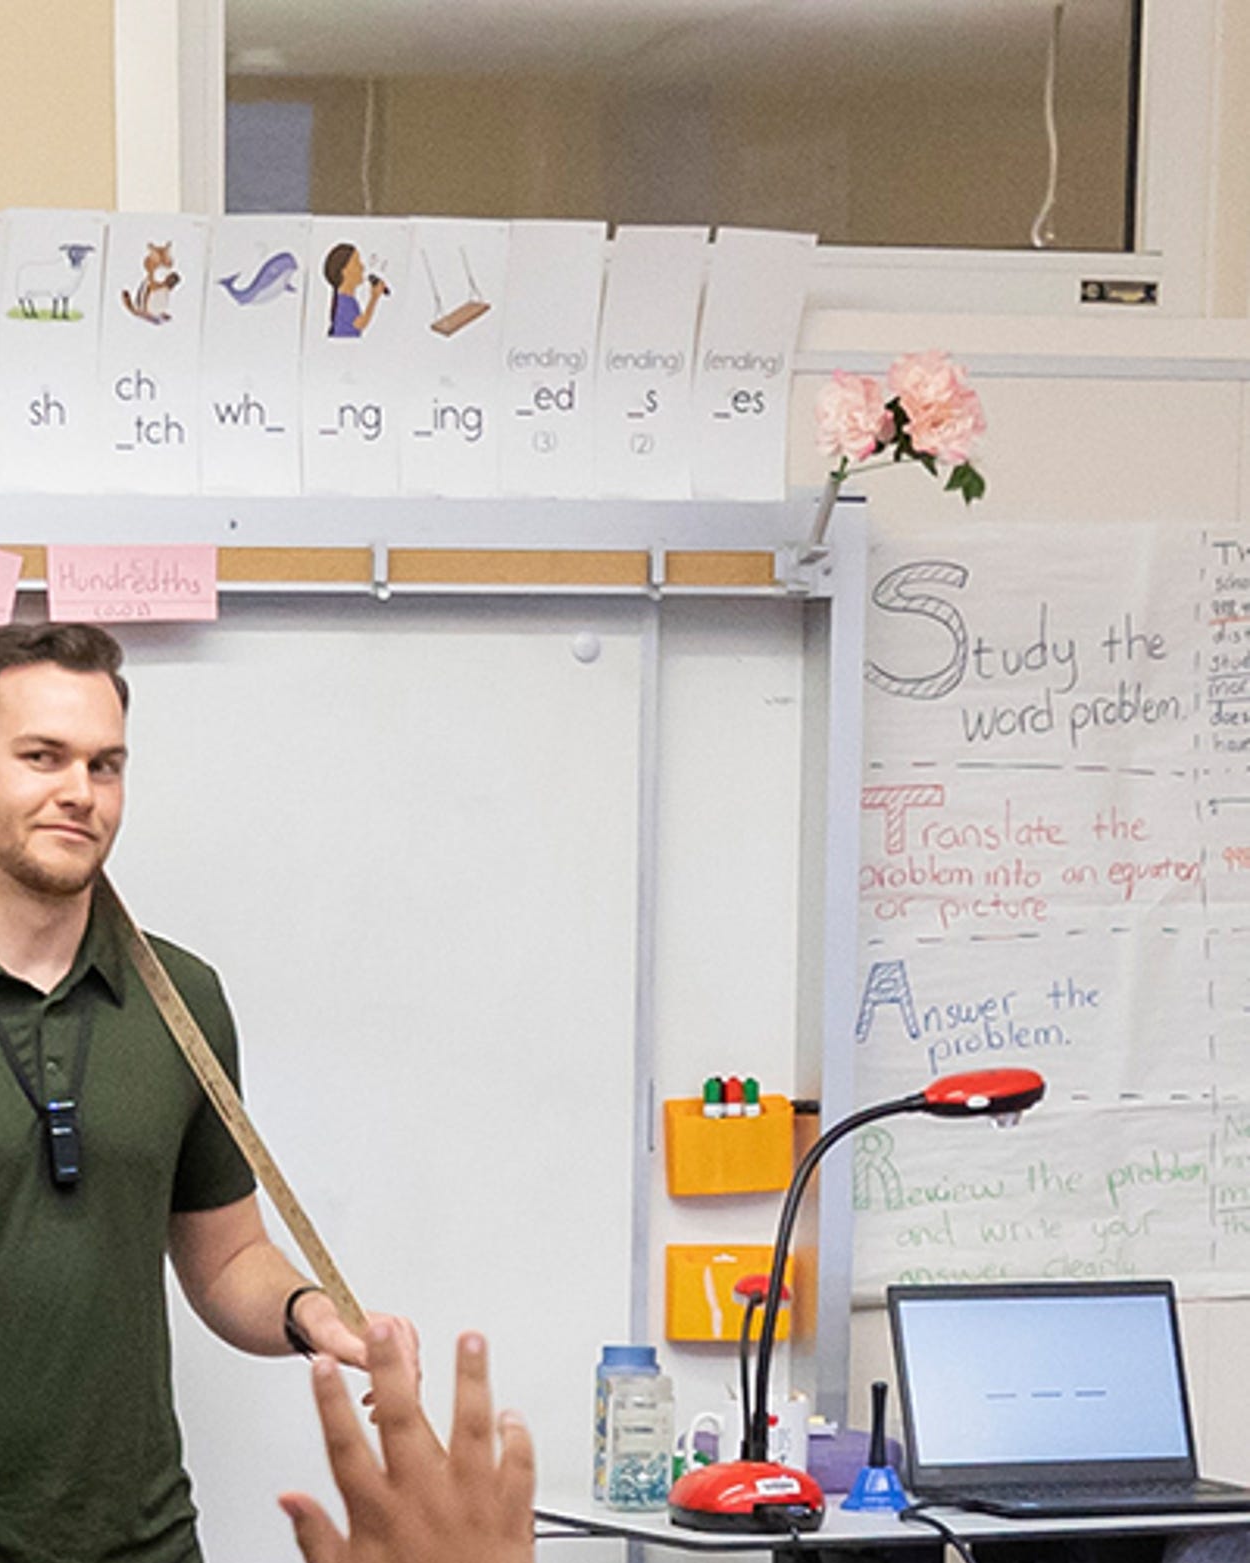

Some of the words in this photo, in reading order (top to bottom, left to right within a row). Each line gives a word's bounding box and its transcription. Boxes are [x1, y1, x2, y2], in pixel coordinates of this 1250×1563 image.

[506, 347, 588, 372] (ending)
[605, 348, 684, 373] (ending)
[703, 350, 785, 377] (ending)
[115, 368, 156, 401] ch
[29, 392, 67, 427] sh
[58, 559, 202, 595] Hundredths
[864, 560, 1078, 700] Study
[1101, 613, 1168, 664] the
[961, 687, 1056, 742] word
[861, 783, 1068, 856] Translate
[1092, 806, 1150, 843] the
[859, 856, 973, 891] problem
[986, 857, 1042, 888] into
[1062, 866, 1098, 886] an
[874, 899, 911, 922] or
[937, 897, 1049, 929] picture
[855, 959, 1019, 1044] Answer
[1047, 978, 1101, 1009] the
[853, 1125, 1005, 1211] Review
[1027, 1161, 1084, 1195] the
[896, 1210, 957, 1248] and
[981, 1221, 1062, 1242] write
[1092, 1208, 1160, 1254] your
